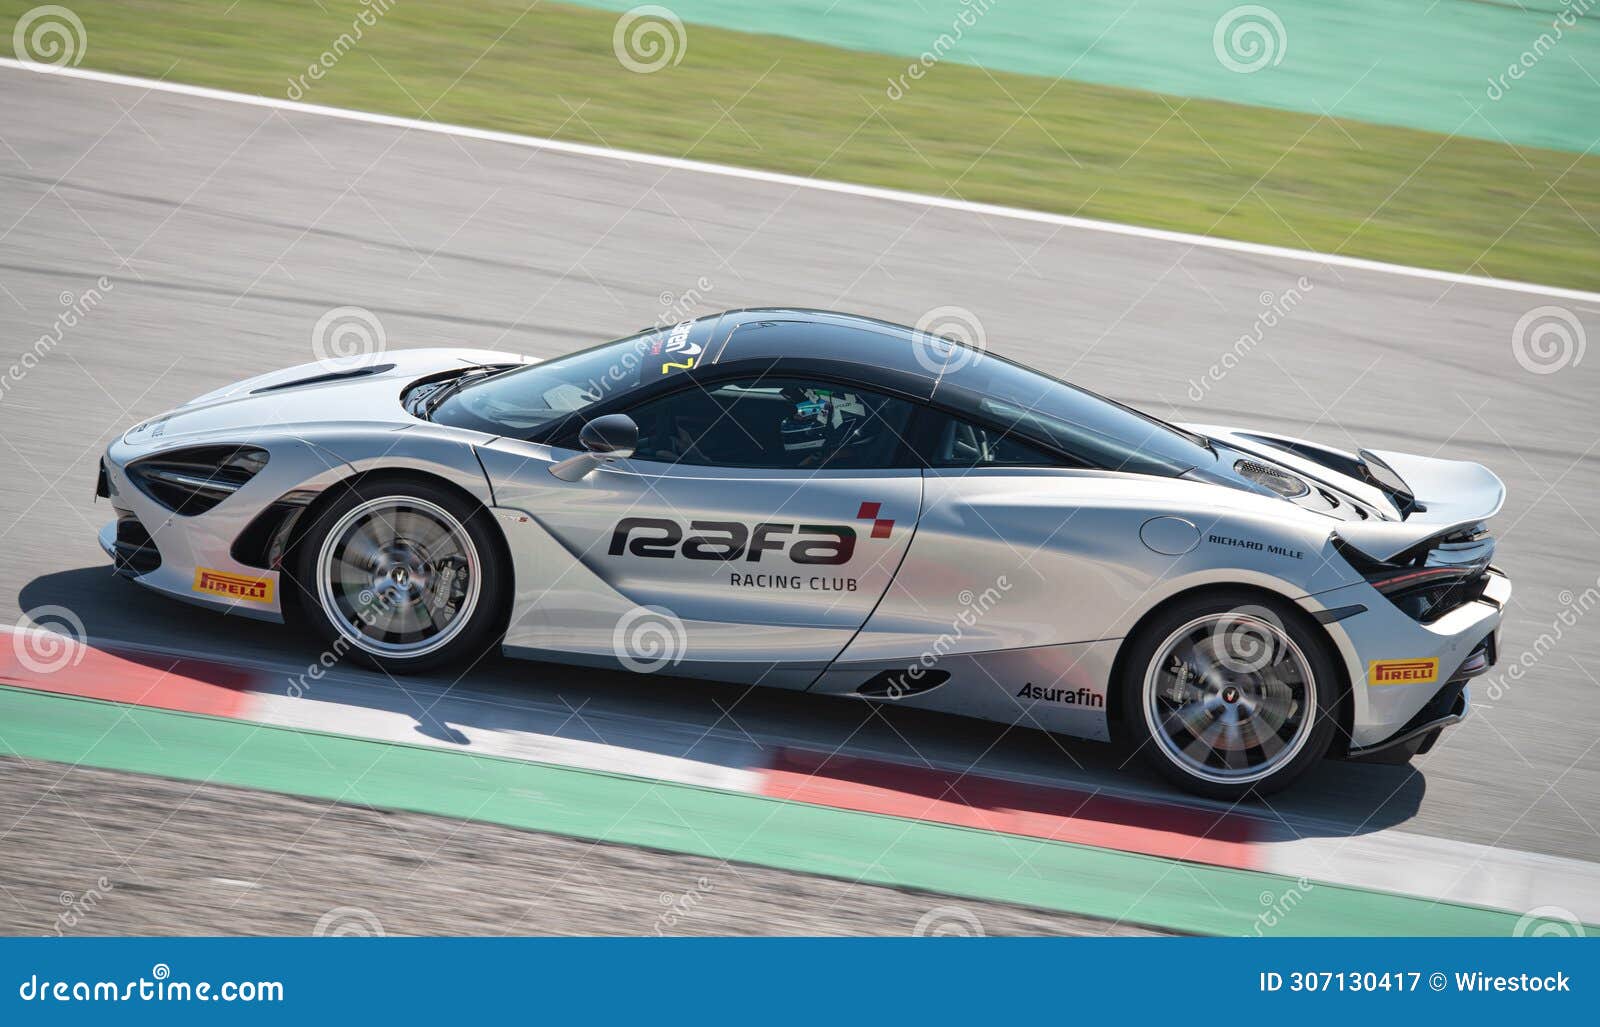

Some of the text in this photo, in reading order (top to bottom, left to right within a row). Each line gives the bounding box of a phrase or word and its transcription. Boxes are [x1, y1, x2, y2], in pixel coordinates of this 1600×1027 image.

[1208, 535, 1304, 560] RICHARD MILLE
[200, 572, 267, 599] PIRELLI
[730, 573, 857, 592] RACING CLUB
[1376, 662, 1434, 681] PIRELLI
[1016, 682, 1104, 708] Asurafin
